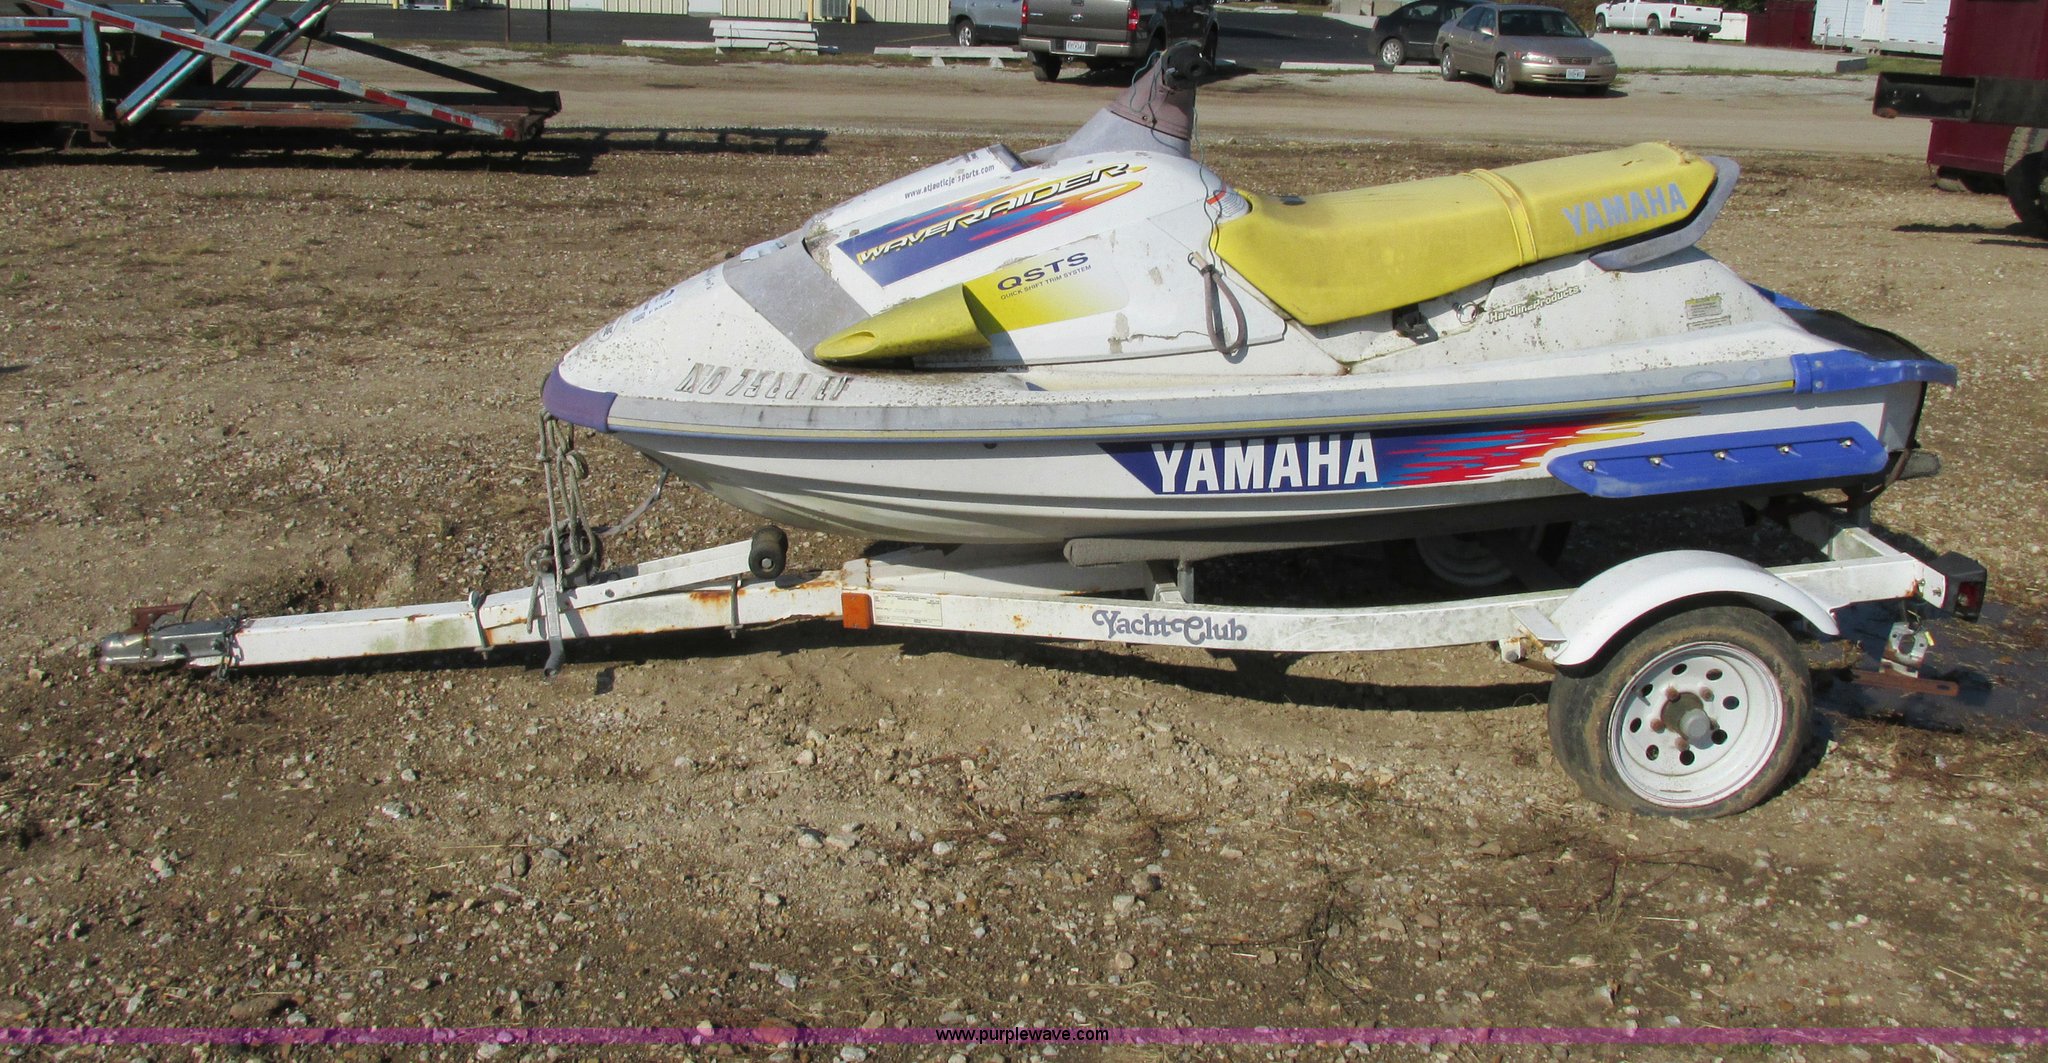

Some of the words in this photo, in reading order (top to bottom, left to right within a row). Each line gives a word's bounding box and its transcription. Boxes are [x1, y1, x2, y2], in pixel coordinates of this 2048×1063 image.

[1563, 182, 1687, 236] YAMAHA
[997, 252, 1089, 291] QSTS
[1000, 289, 1023, 300] QUICK
[1024, 281, 1043, 291] SHIFT
[1045, 274, 1062, 284] TRIM
[1063, 264, 1091, 279] SYSTEM
[1151, 432, 1378, 493] YAMAHA
